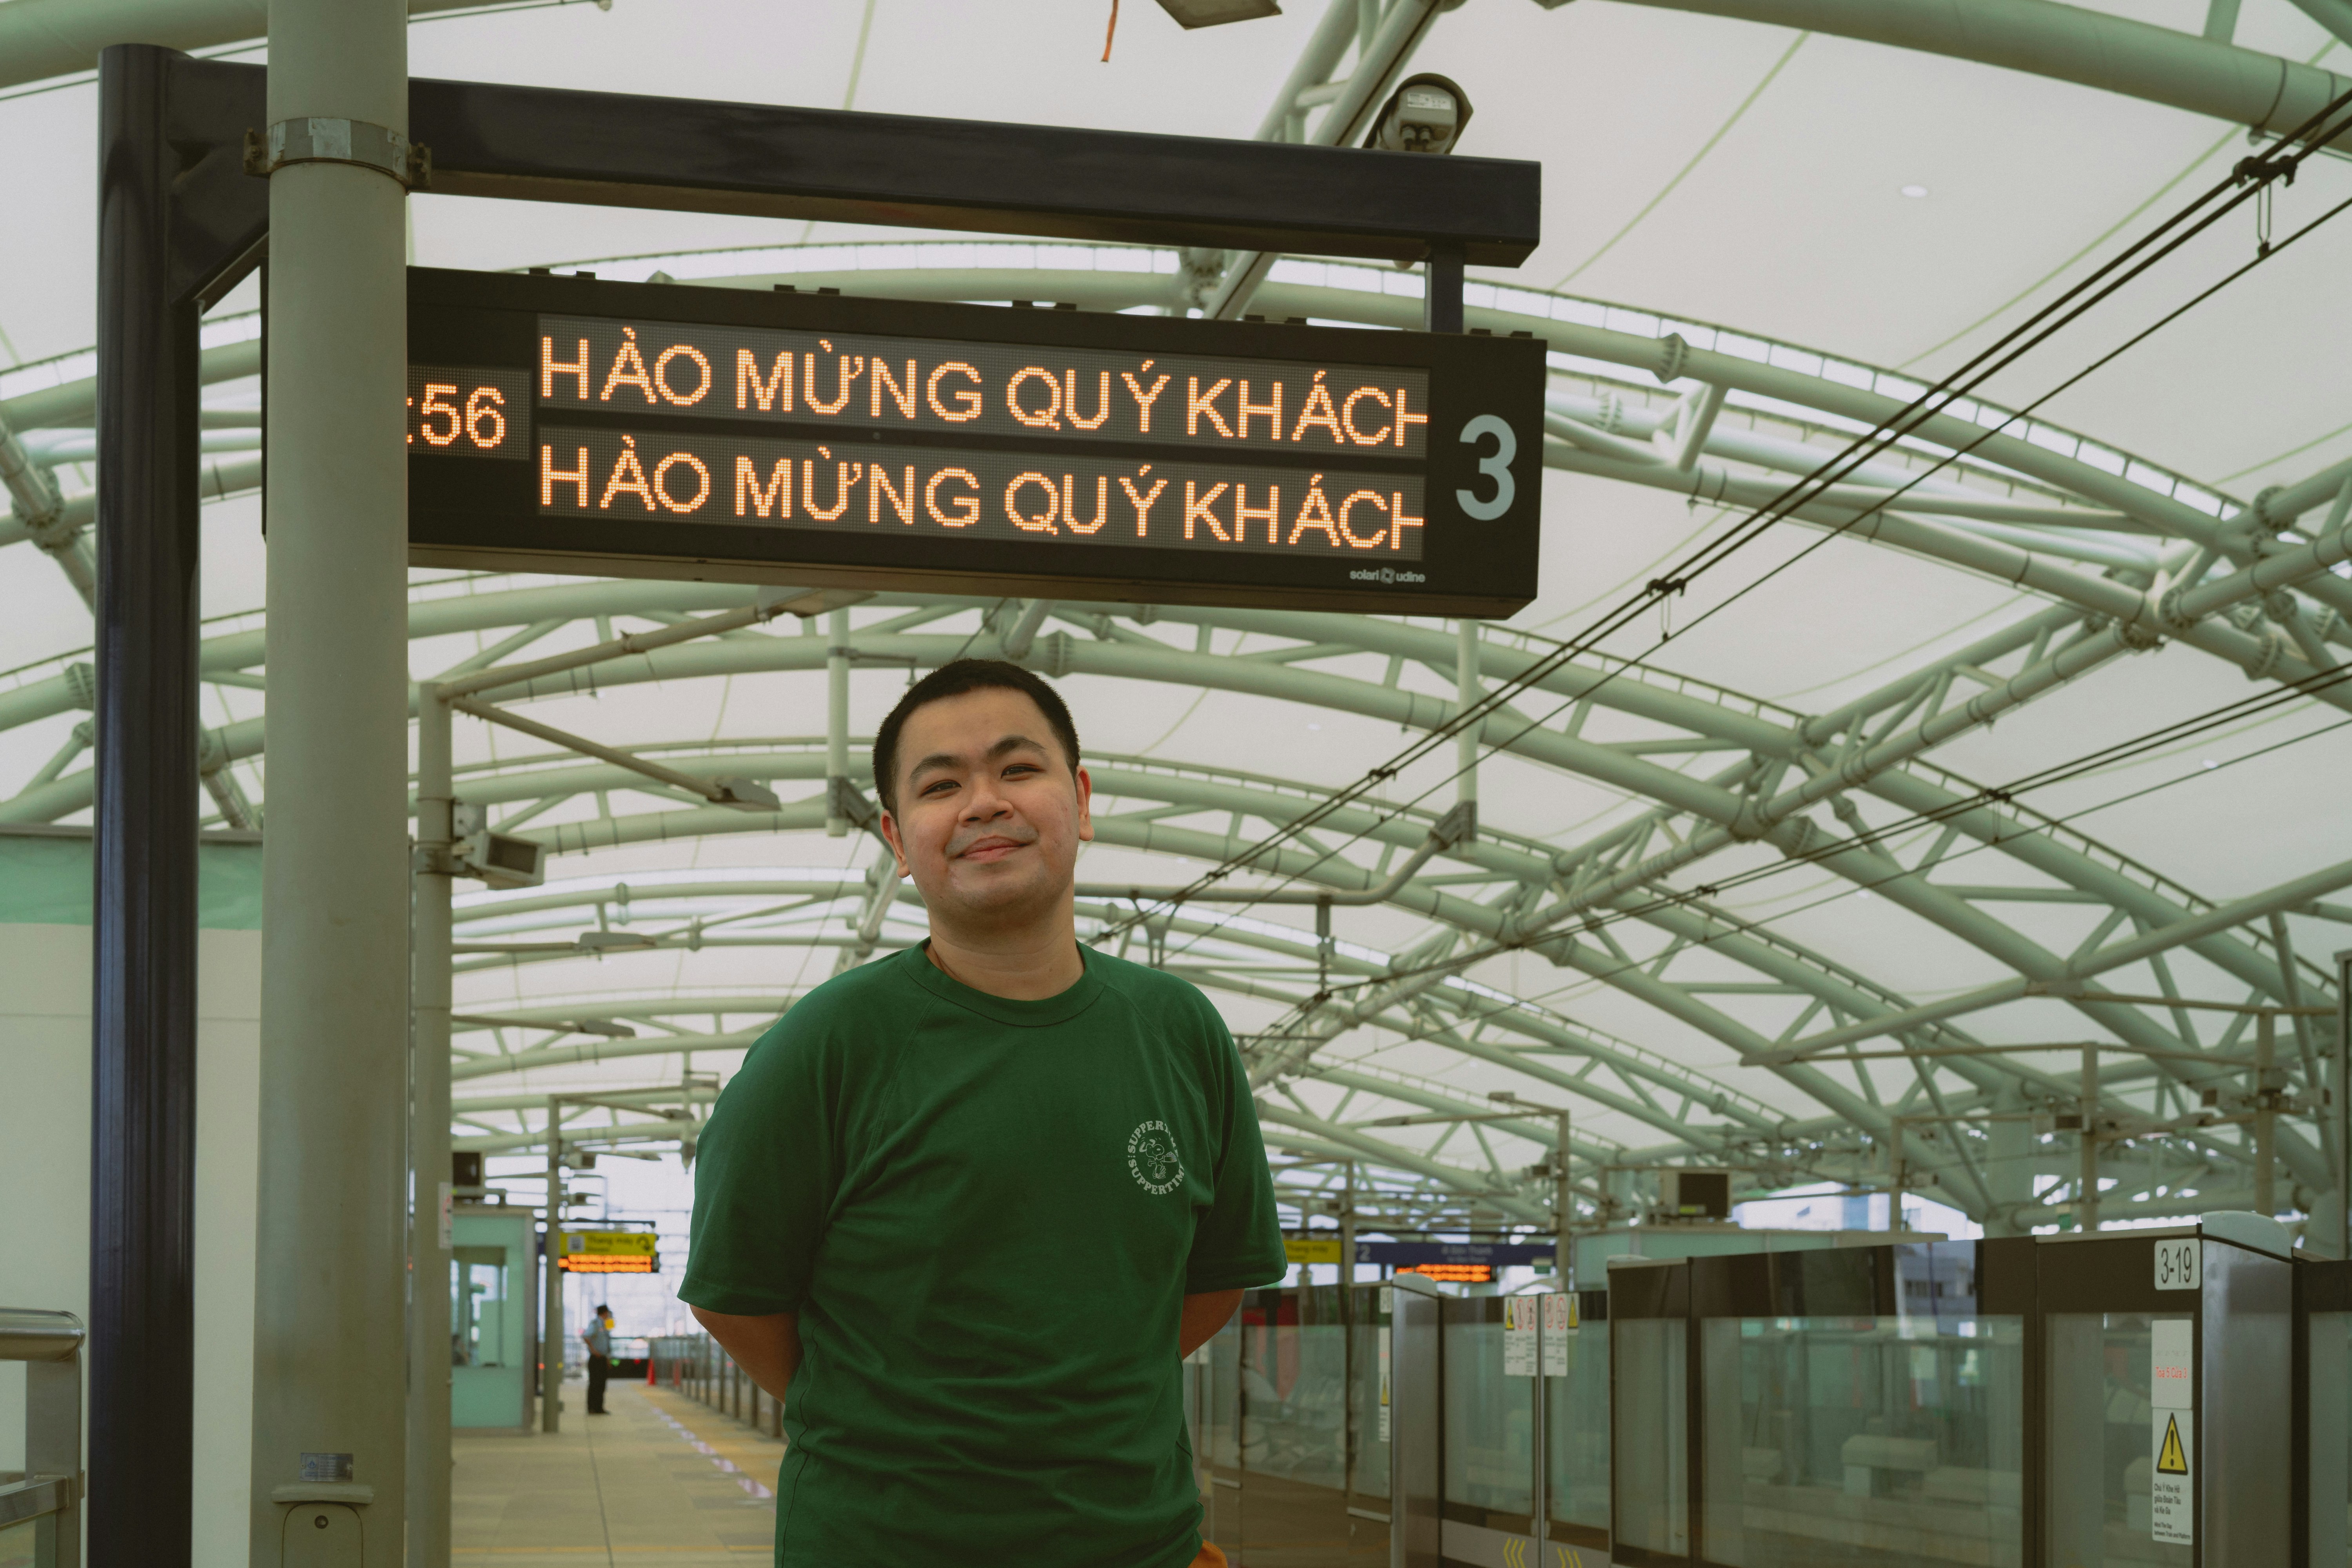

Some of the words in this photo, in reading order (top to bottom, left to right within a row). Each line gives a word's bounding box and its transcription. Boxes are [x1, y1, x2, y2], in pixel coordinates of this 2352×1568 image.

[541, 326, 712, 407] HÀO
[735, 339, 983, 423] MỪNG
[1005, 359, 1172, 433] QUÝ
[541, 434, 711, 514] HÀO
[734, 445, 981, 528] MỪNG
[1004, 463, 1169, 537] QUÝ
[1455, 414, 1517, 521] 3
[1349, 569, 1379, 581] solari
[1395, 571, 1426, 583] udine
[2161, 1246, 2192, 1284] 3-19
[2155, 1367, 2165, 1378] Toa
[2166, 1367, 2170, 1378] 5
[2183, 1367, 2187, 1379] 3
